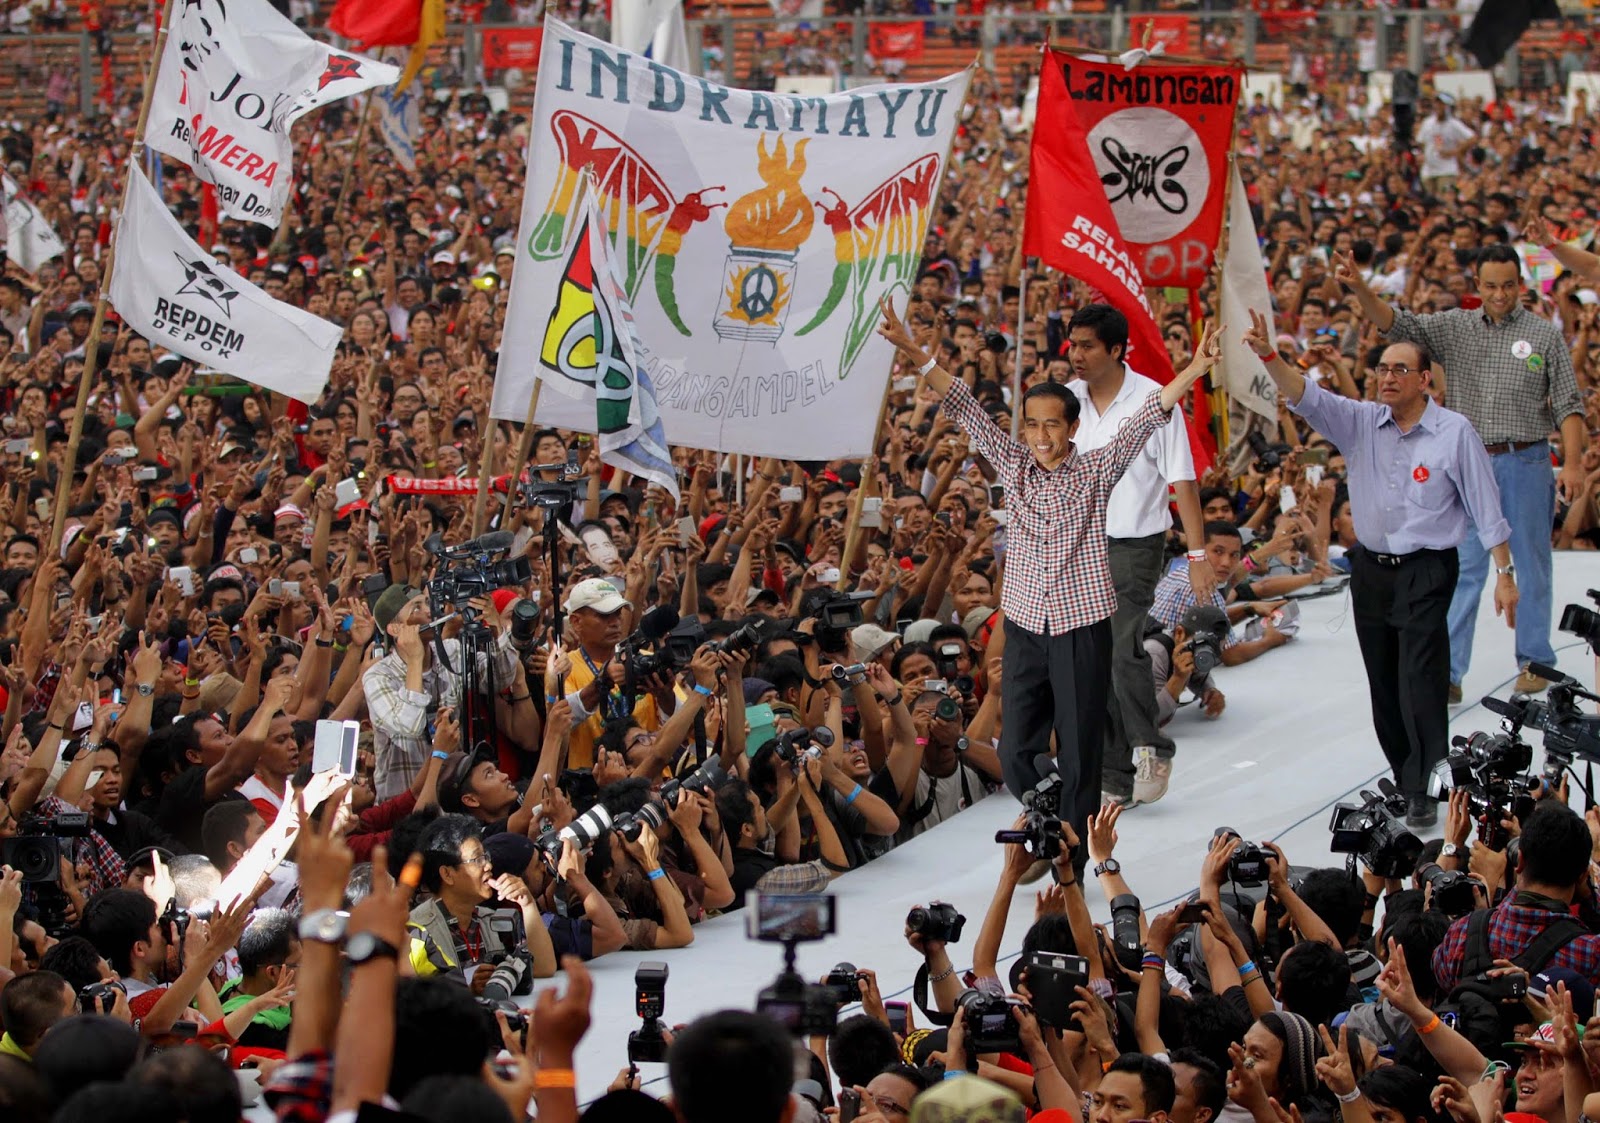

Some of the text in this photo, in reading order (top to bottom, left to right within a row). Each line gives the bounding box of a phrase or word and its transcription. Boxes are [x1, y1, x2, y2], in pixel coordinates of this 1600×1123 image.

[556, 39, 948, 138] INDRAMAYU
[1061, 232, 1154, 320] SAHABA
[152, 319, 231, 359] DEPOK
[154, 297, 245, 352] REPDEM
